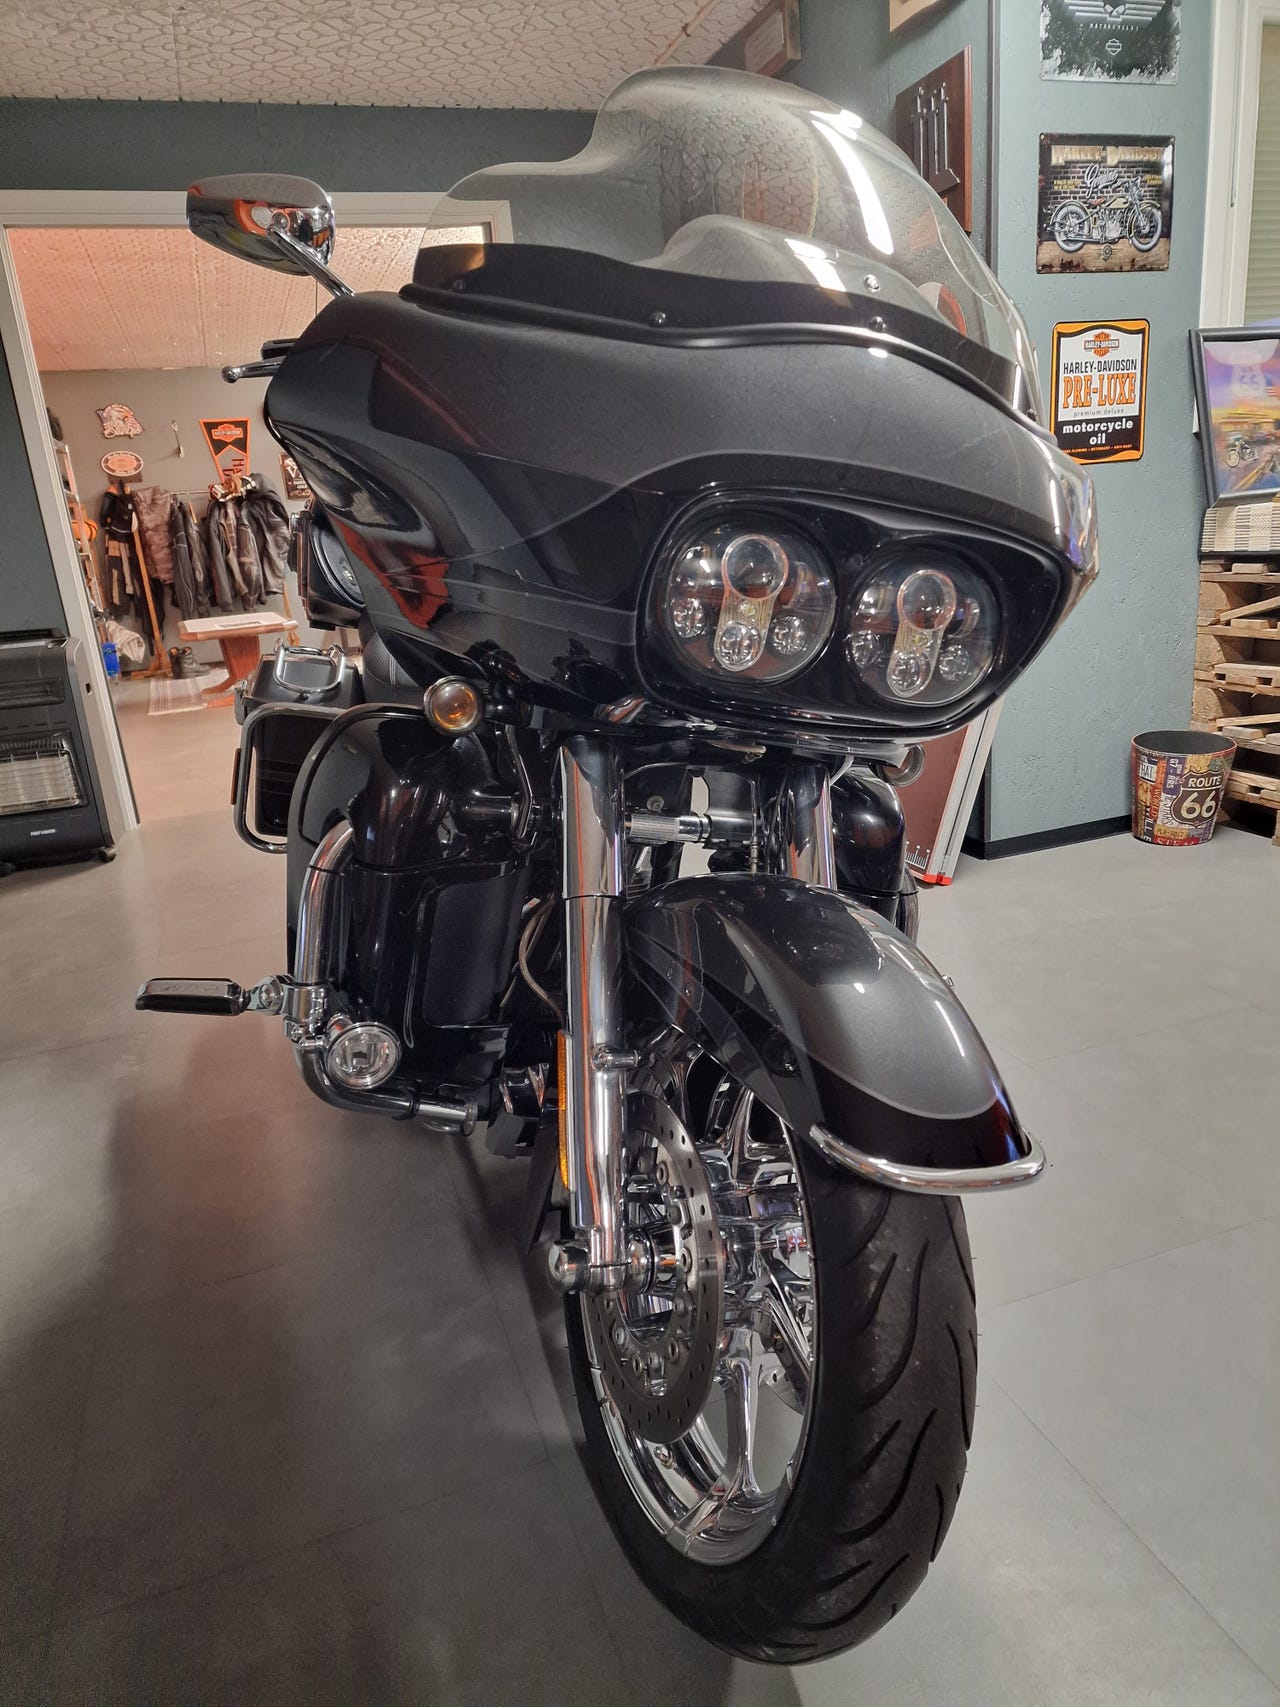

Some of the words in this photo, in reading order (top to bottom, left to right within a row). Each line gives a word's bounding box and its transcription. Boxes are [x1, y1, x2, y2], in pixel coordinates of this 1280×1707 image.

[1063, 359, 1137, 374] HARLEY-DAVIDSON
[1062, 372, 1137, 409] PRE-LUXE
[1073, 410, 1101, 418] premium
[1062, 418, 1134, 434] motorcycle
[1089, 433, 1106, 445] oil
[1188, 775, 1222, 788] ROUTE
[1181, 790, 1216, 819] 66
